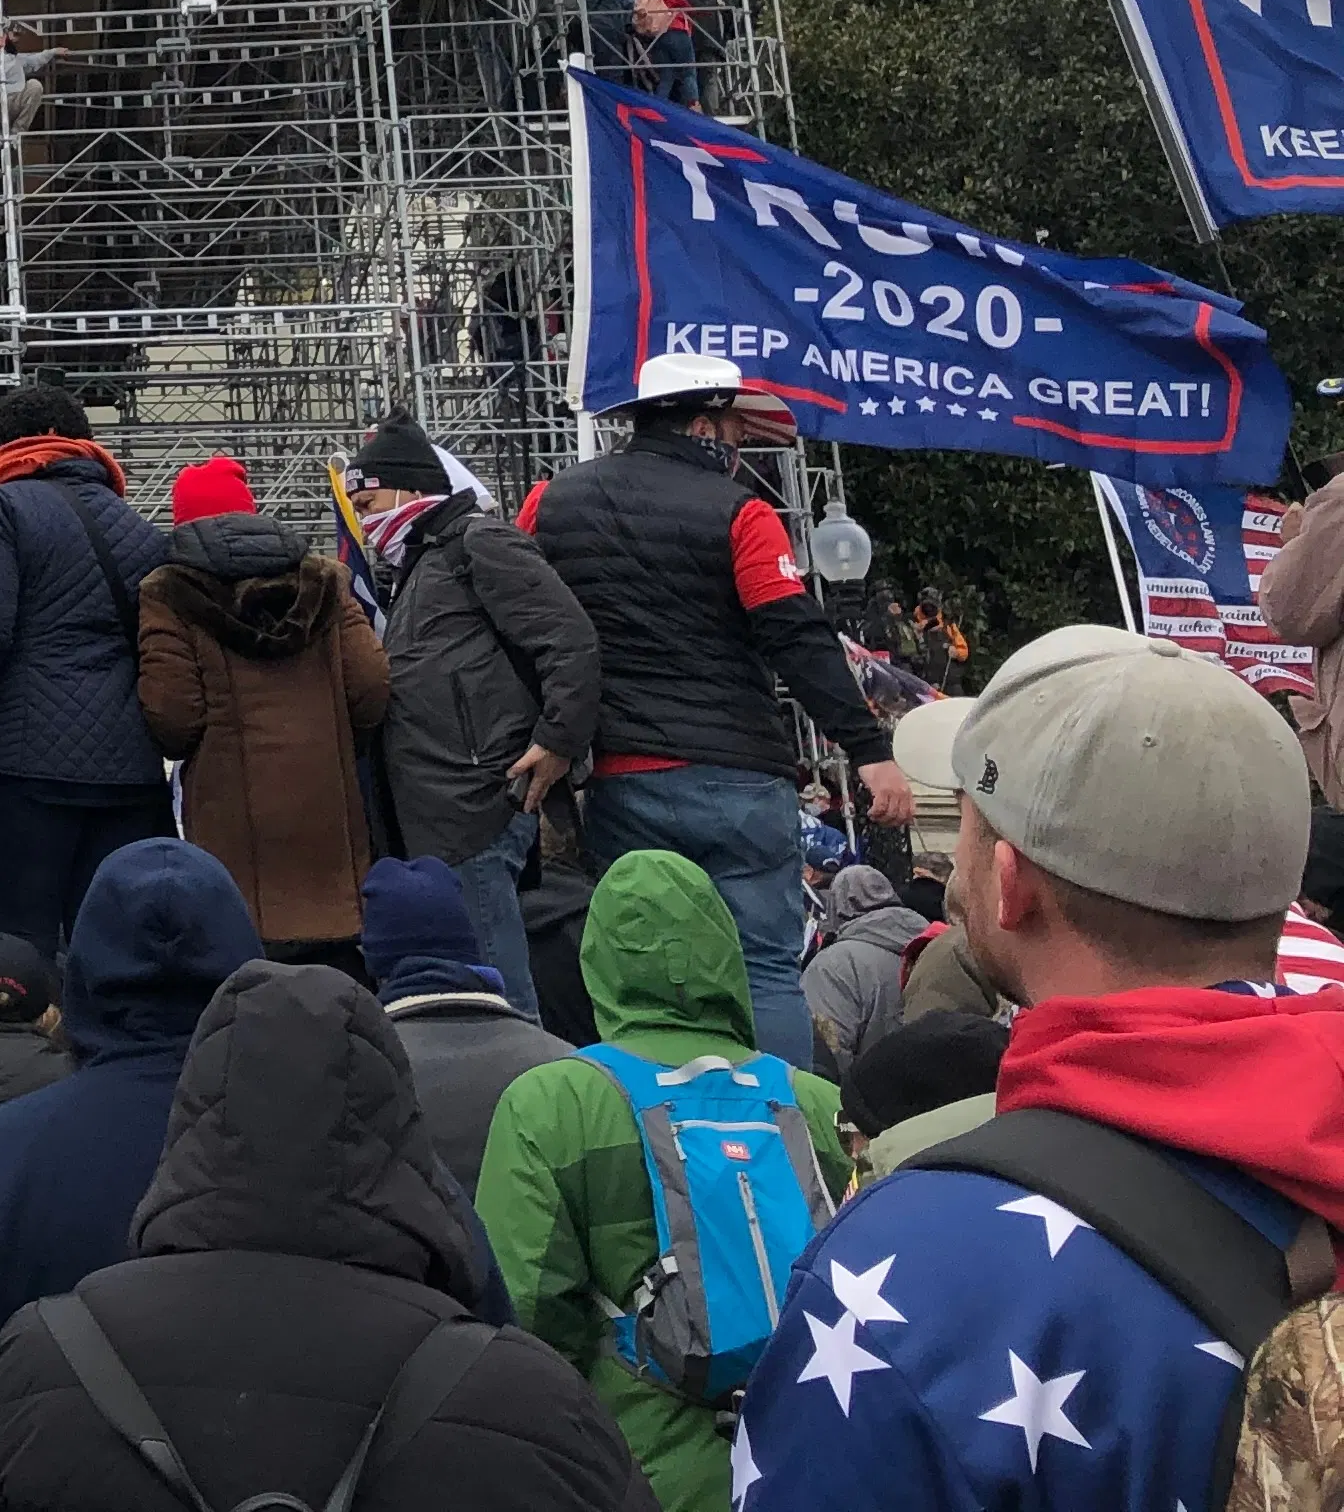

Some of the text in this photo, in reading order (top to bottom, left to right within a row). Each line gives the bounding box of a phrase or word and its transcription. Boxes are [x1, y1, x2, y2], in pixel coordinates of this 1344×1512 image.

[794, 260, 1063, 350] -2020-
[666, 321, 1212, 418] KEEP AMERICA GREAT!
[1292, 650, 1309, 659] to
